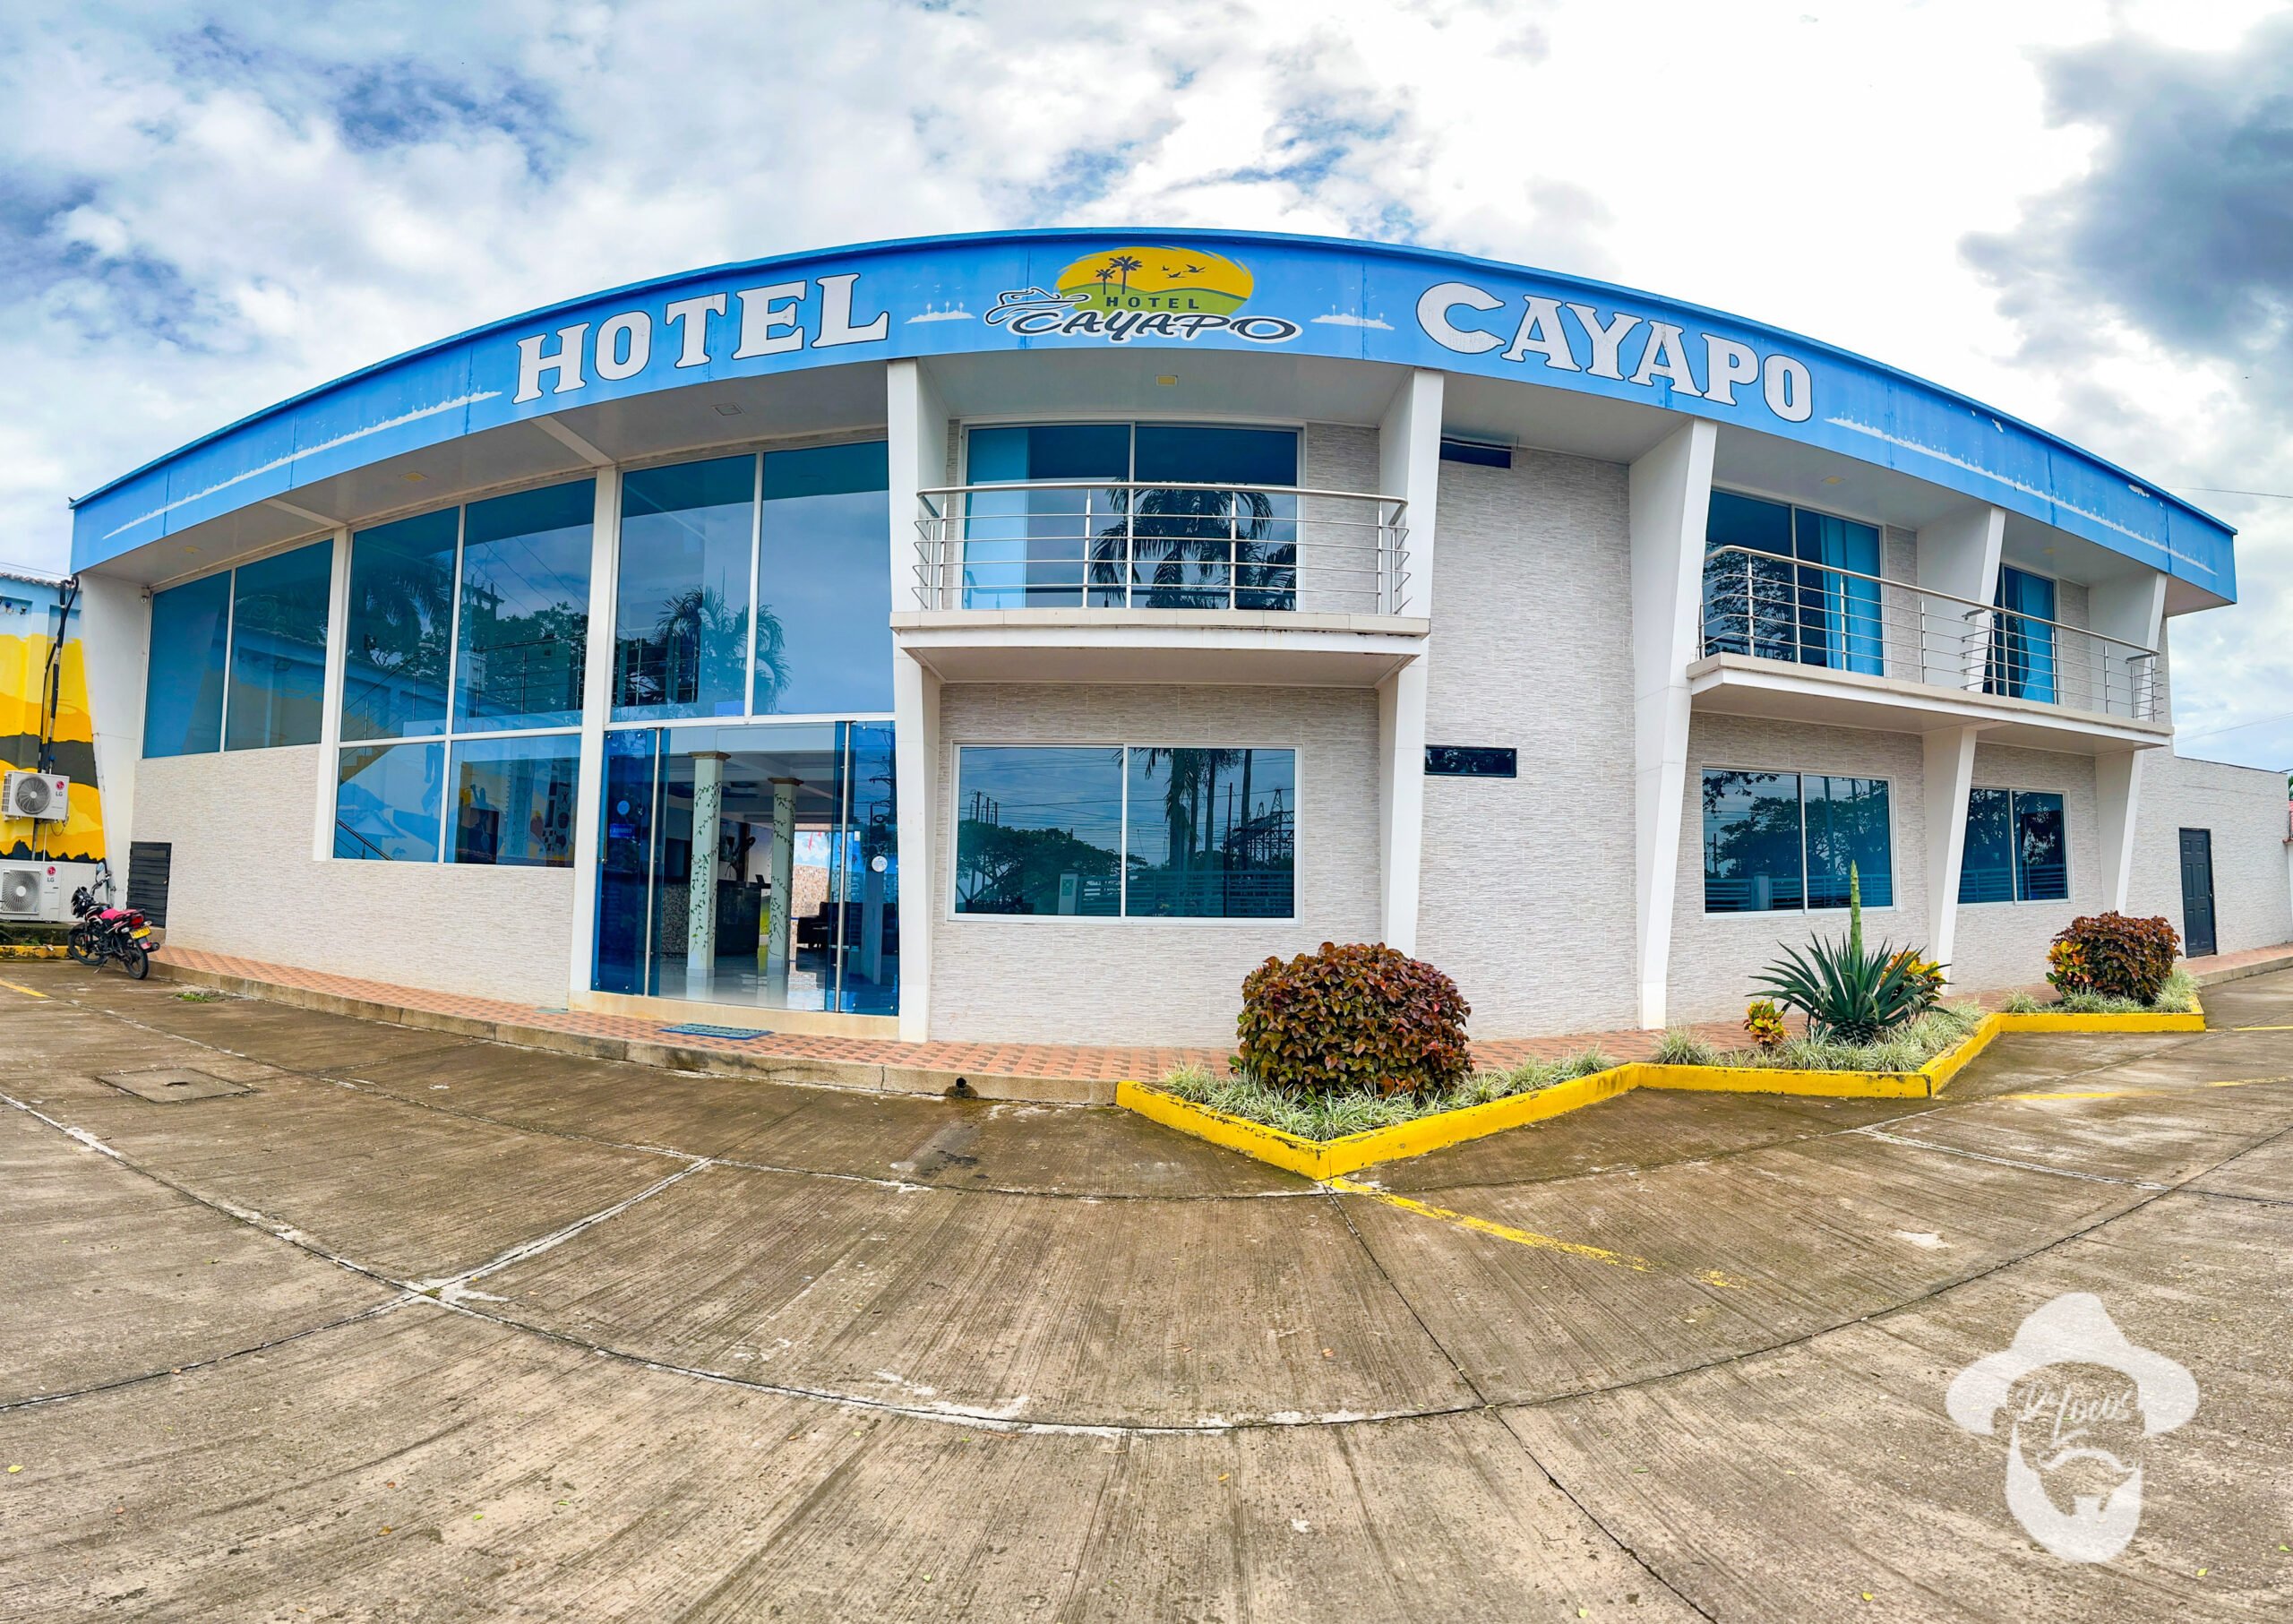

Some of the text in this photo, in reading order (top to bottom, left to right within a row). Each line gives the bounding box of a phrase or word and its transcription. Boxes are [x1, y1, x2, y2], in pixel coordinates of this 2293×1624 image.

[1105, 296, 1200, 310] HOTEL
[1010, 310, 1299, 342] CAYAPO
[511, 272, 1813, 423] HOTEL CAYAPO
